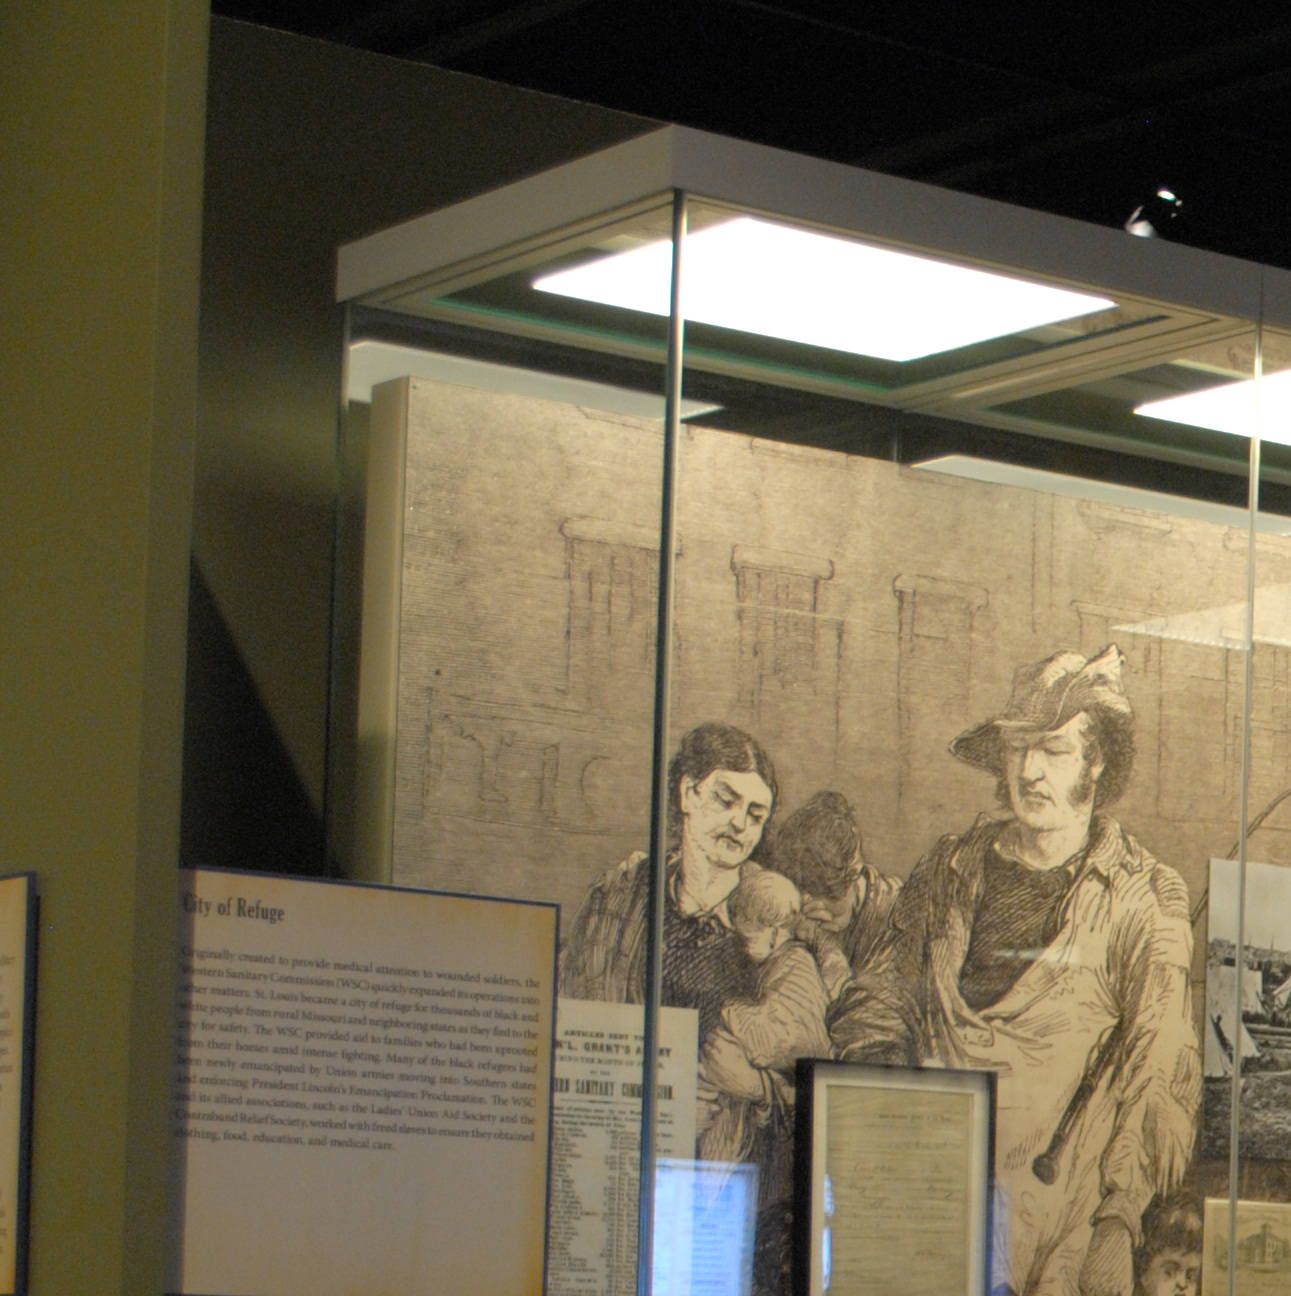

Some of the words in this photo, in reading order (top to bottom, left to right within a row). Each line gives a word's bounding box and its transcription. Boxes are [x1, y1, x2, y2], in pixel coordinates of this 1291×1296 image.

[184, 893, 212, 918] City
[218, 897, 231, 916] of
[237, 898, 285, 923] Refuge
[238, 952, 275, 964] created
[278, 956, 288, 965] to
[291, 956, 330, 972] provide
[333, 960, 372, 973] medical
[375, 964, 420, 977] attention
[422, 969, 432, 978] to
[435, 969, 480, 982] wounded
[483, 973, 522, 987] soldiers,
[525, 977, 540, 987] the
[225, 969, 269, 985] Sanitary
[269, 972, 334, 987] Commission
[335, 978, 369, 993] (WSC)
[370, 981, 407, 997] quickly
[408, 984, 456, 1001] expanded
[457, 989, 468, 998] its
[469, 990, 520, 1006] operations
[520, 994, 540, 1004] into
[210, 987, 250, 998] matters.
[254, 989, 266, 999] St.
[269, 990, 298, 1002] Louis
[300, 993, 339, 1005] became
[348, 997, 367, 1011] city
[369, 999, 379, 1008] of
[381, 1000, 411, 1014] refuge
[413, 1002, 428, 1012] for
[430, 1004, 480, 1017] thousands
[482, 1008, 493, 1018] of
[493, 1009, 519, 1020] black
[521, 1011, 539, 1021] and
[209, 1004, 244, 1019] people
[245, 1006, 271, 1018] from
[273, 1009, 299, 1020] rural
[301, 1011, 346, 1024] Missouri
[347, 1015, 366, 1025] and
[368, 1016, 428, 1033] neighboring
[429, 1022, 457, 1032] states
[469, 1024, 490, 1038] they
[492, 1026, 510, 1036] fled
[511, 1029, 522, 1037] to
[522, 1029, 538, 1039] the
[201, 1021, 215, 1031] for
[218, 1022, 249, 1037] safety.
[253, 1025, 273, 1036] The
[276, 1027, 302, 1038] WSC
[305, 1029, 349, 1045] provided
[352, 1033, 368, 1043] aid
[371, 1035, 380, 1044] to
[383, 1035, 422, 1047] families
[425, 1038, 446, 1049] who
[449, 1040, 466, 1050] had
[469, 1042, 492, 1052] been
[495, 1044, 538, 1059] uprooted
[584, 1042, 631, 1055] GRANT'S
[207, 1040, 232, 1051] their
[235, 1042, 269, 1053] homes
[272, 1044, 298, 1055] amid
[301, 1047, 337, 1058] intense
[340, 1050, 382, 1065] fighting.
[386, 1053, 414, 1067] Many
[417, 1055, 428, 1065] of
[430, 1056, 446, 1066] the
[449, 1058, 474, 1068] black
[477, 1060, 516, 1075] refugees
[519, 1063, 537, 1073] had
[205, 1058, 236, 1073] newly
[240, 1060, 305, 1077] emancipated
[308, 1065, 322, 1078] by
[325, 1066, 357, 1077] Union
[361, 1069, 395, 1080] armies
[398, 1071, 436, 1086] moving
[439, 1074, 460, 1085] into
[462, 1076, 507, 1088] Southern
[510, 1081, 536, 1090] states
[575, 1079, 615, 1097] SANITARY
[199, 1075, 249, 1091] enforcing
[251, 1079, 298, 1091] President
[301, 1082, 346, 1094] Lincoln's
[348, 1086, 418, 1103] Emancipation
[420, 1090, 487, 1104] Proclamation.
[491, 1095, 509, 1105] The
[511, 1097, 536, 1107] WSC
[198, 1094, 211, 1104] its
[214, 1095, 242, 1106] allied
[245, 1097, 310, 1111] associations,
[312, 1101, 335, 1111] such
[351, 1103, 368, 1113] the
[370, 1105, 404, 1116] Ladies'
[407, 1107, 438, 1118] Union
[441, 1109, 460, 1119] Aid
[461, 1111, 496, 1125] Society
[499, 1113, 517, 1123] and
[520, 1114, 535, 1124] the
[223, 1131, 249, 1143] food,
[252, 1133, 304, 1147] education,
[307, 1136, 327, 1146] and
[329, 1138, 369, 1149] medical
[239, 1114, 268, 1125] Relief
[269, 1116, 309, 1131] Society,
[309, 1119, 347, 1130] worked
[347, 1121, 370, 1131] with
[371, 1122, 397, 1133] freed
[397, 1124, 426, 1135] slaves
[427, 1127, 437, 1135] to
[438, 1129, 470, 1137] ensure
[471, 1129, 492, 1142] they
[493, 1130, 534, 1141] obtained
